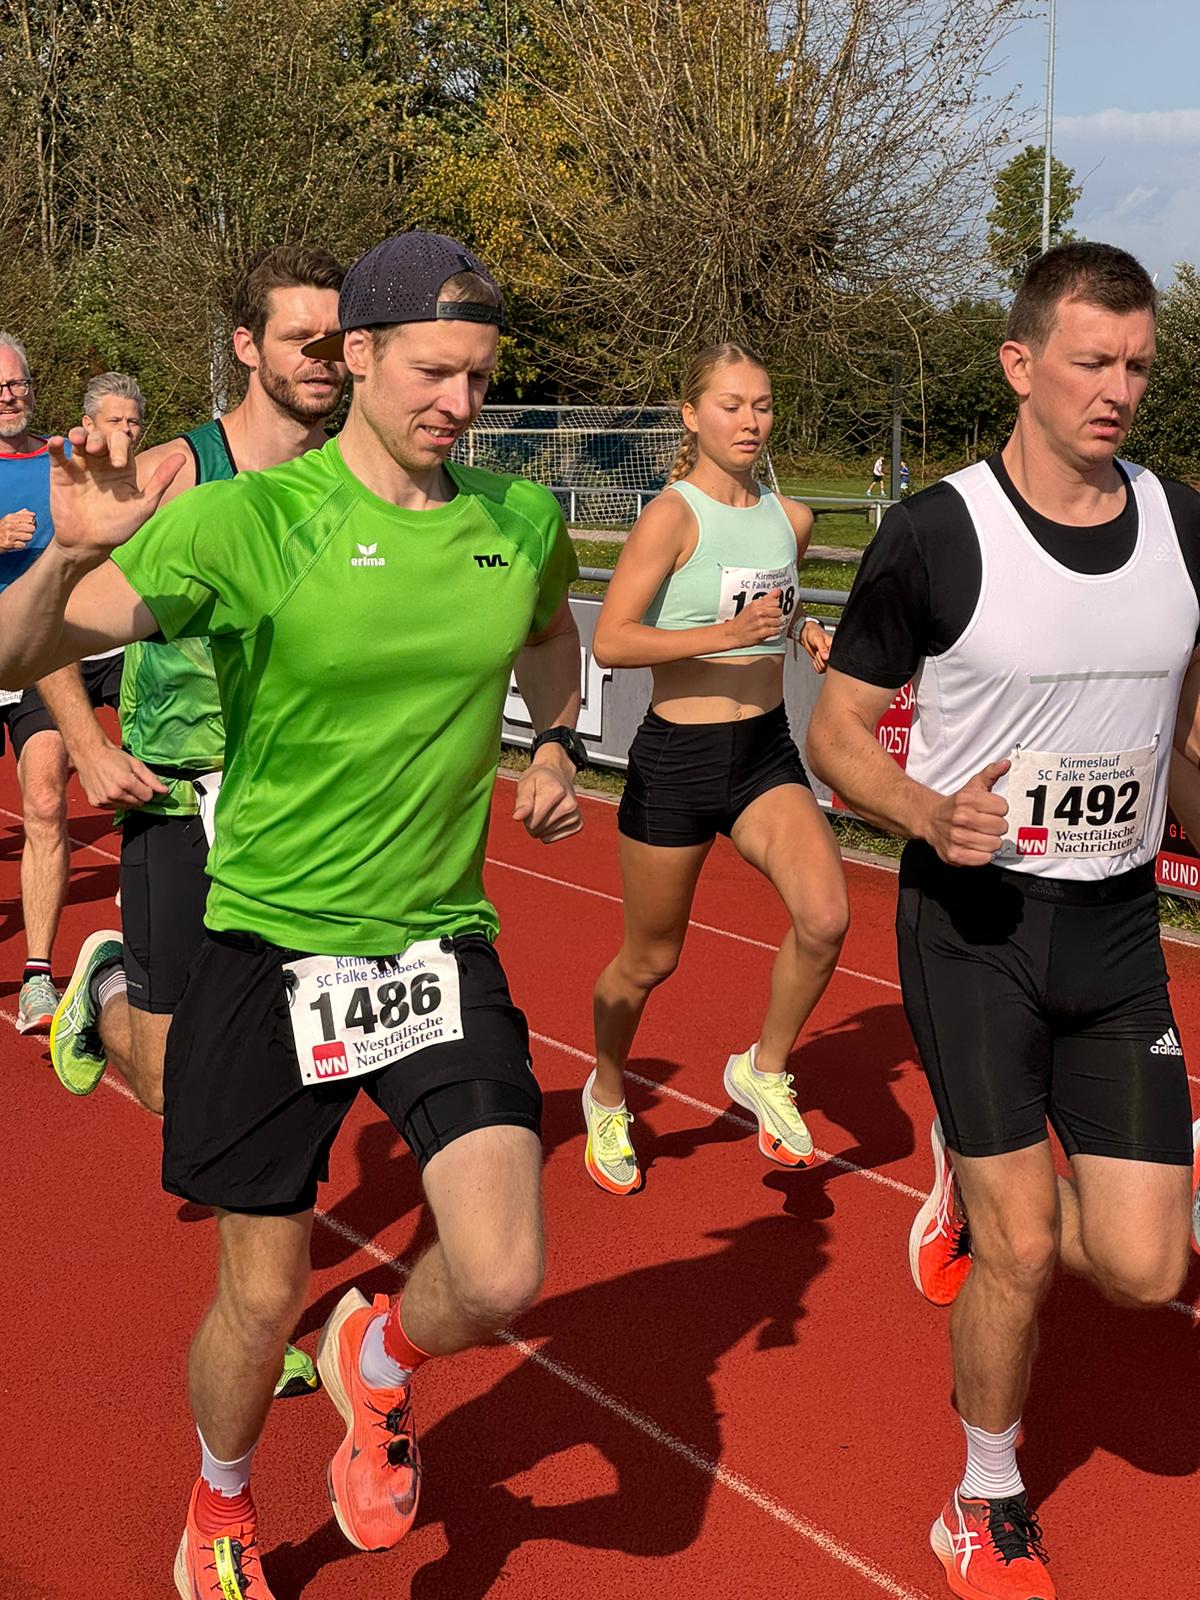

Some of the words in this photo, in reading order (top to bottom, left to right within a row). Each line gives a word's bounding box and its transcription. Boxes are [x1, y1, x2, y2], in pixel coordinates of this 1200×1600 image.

[351, 557, 386, 567] erima
[740, 580, 750, 589] SC
[752, 581, 771, 589] Falke
[1060, 755, 1120, 768] Kirmeslauf
[1038, 770, 1052, 781] SC
[1056, 771, 1085, 781] Falke
[1089, 766, 1135, 781] Saerbeck
[1026, 781, 1140, 826] 1492
[1056, 825, 1135, 841] Westfälische
[1018, 839, 1046, 853] WN
[1055, 838, 1132, 852] Nachrichten
[1161, 859, 1199, 886] RUND
[316, 974, 333, 988] SC
[336, 970, 368, 984] Falke
[371, 959, 426, 979] Saerbeck
[310, 973, 442, 1041] 1486
[353, 1016, 444, 1054] Westfälische
[356, 1028, 444, 1068] Nachrichten
[315, 1055, 348, 1076] WN
